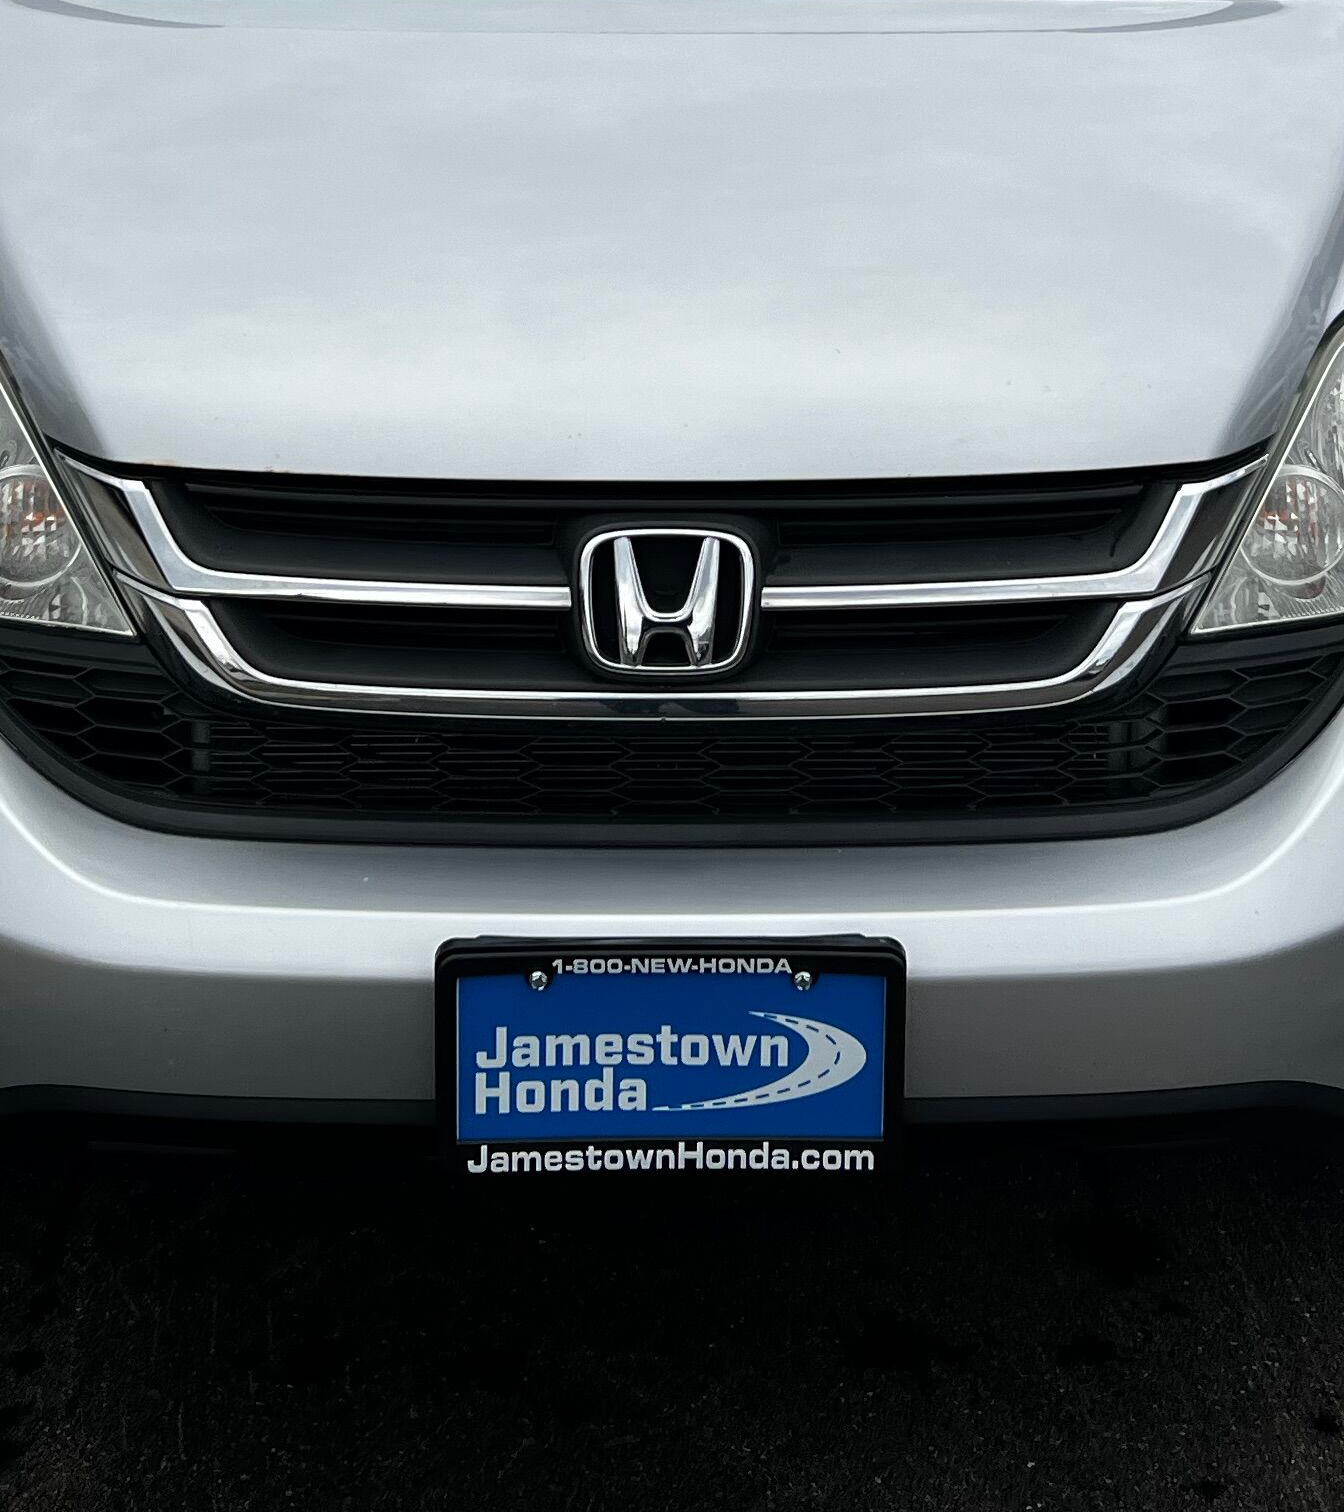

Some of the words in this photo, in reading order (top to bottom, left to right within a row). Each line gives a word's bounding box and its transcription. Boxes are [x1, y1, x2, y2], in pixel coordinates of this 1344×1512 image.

[552, 958, 793, 975] 1-800-NEW-HONDA
[475, 1025, 790, 1069] Jamestown
[474, 1067, 648, 1115] Honda
[467, 1141, 875, 1174] JamestownHonda.com
